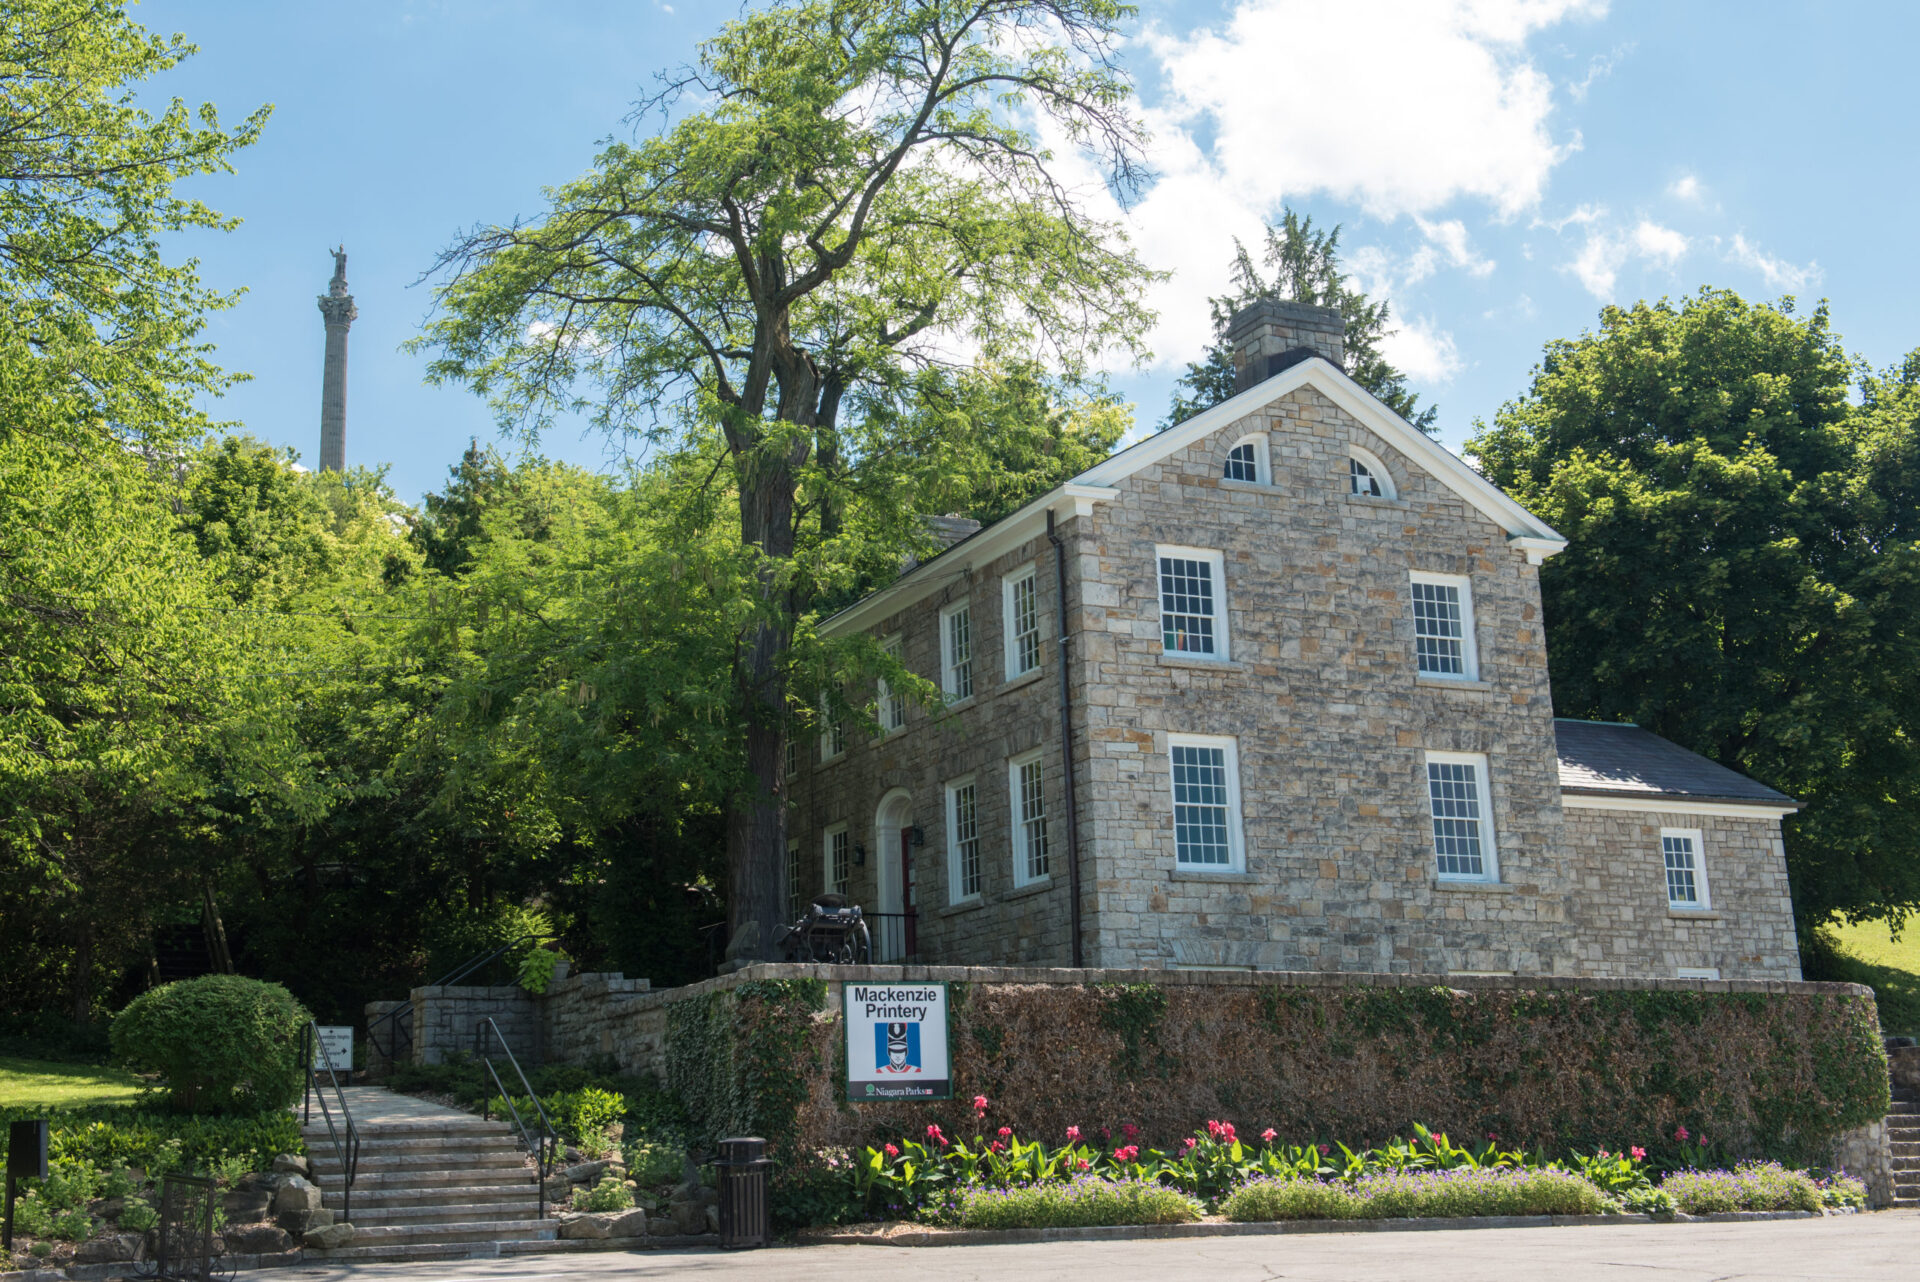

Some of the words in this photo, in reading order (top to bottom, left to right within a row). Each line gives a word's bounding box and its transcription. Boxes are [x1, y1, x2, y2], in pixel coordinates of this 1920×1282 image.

[855, 987, 937, 1002] Mackenzie
[866, 1003, 927, 1022] Printery
[876, 1087, 905, 1097] Niagara
[905, 1086, 925, 1096] Parks
